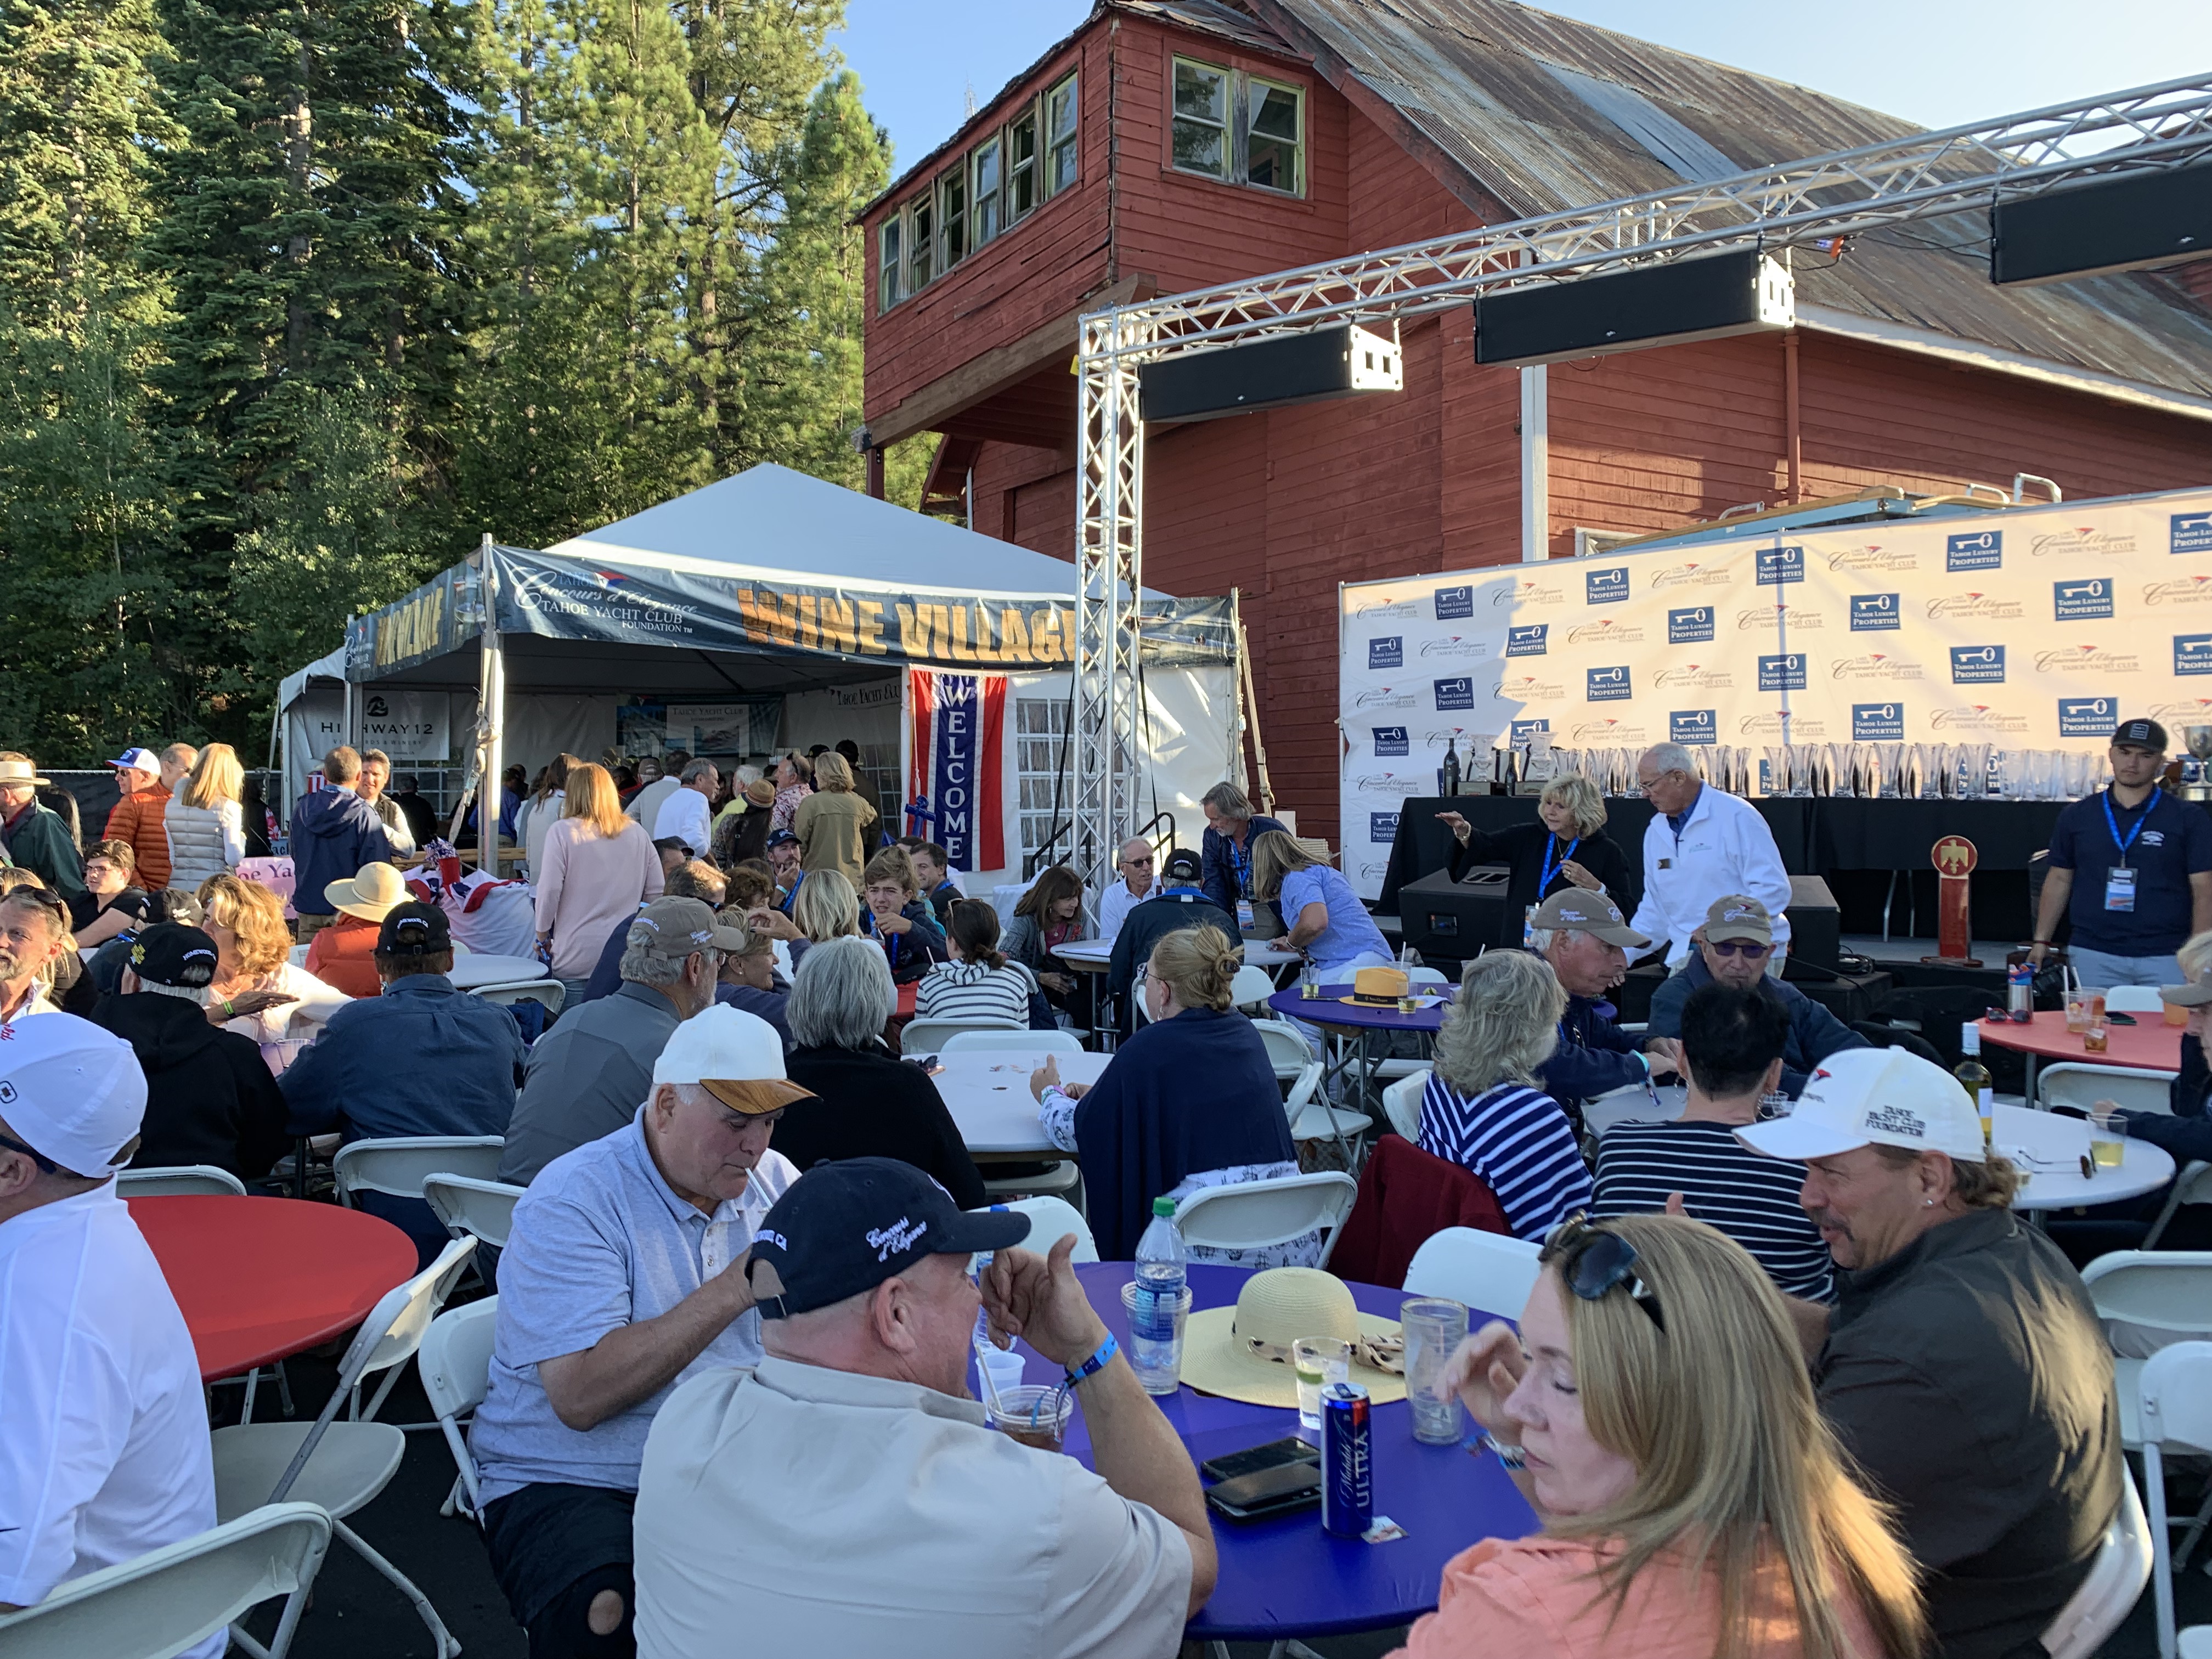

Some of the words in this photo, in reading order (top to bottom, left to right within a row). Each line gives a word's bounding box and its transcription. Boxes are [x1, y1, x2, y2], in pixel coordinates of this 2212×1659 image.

[1949, 555, 1999, 566] PROPERTIES
[1759, 569, 1802, 579] PROPERTIES
[509, 566, 603, 610] Concours
[1589, 589, 1626, 599] PROPERTIES
[541, 600, 589, 616] TAHOE
[593, 605, 641, 620] YACHT
[645, 611, 683, 624] CLUB
[1438, 606, 1471, 614] PROPERTIES
[2058, 603, 2111, 614] PROPERTIES
[737, 587, 887, 656] WINE
[1853, 616, 1899, 625] PROPERTIES
[622, 620, 682, 633] FOUNDATION
[1671, 628, 1712, 638] PROPERTIES
[1508, 643, 1545, 652] PROPERTIES
[1370, 656, 1401, 664] PROPERTIES
[1955, 669, 2003, 678] PROPERTIES
[1761, 676, 1804, 685] PROPERTIES
[1589, 687, 1629, 696] PROPERTIES
[1673, 731, 1714, 740] PROPERTIES
[944, 685, 972, 859] WELCOME
[1354, 1429, 1370, 1508] ULTRA
